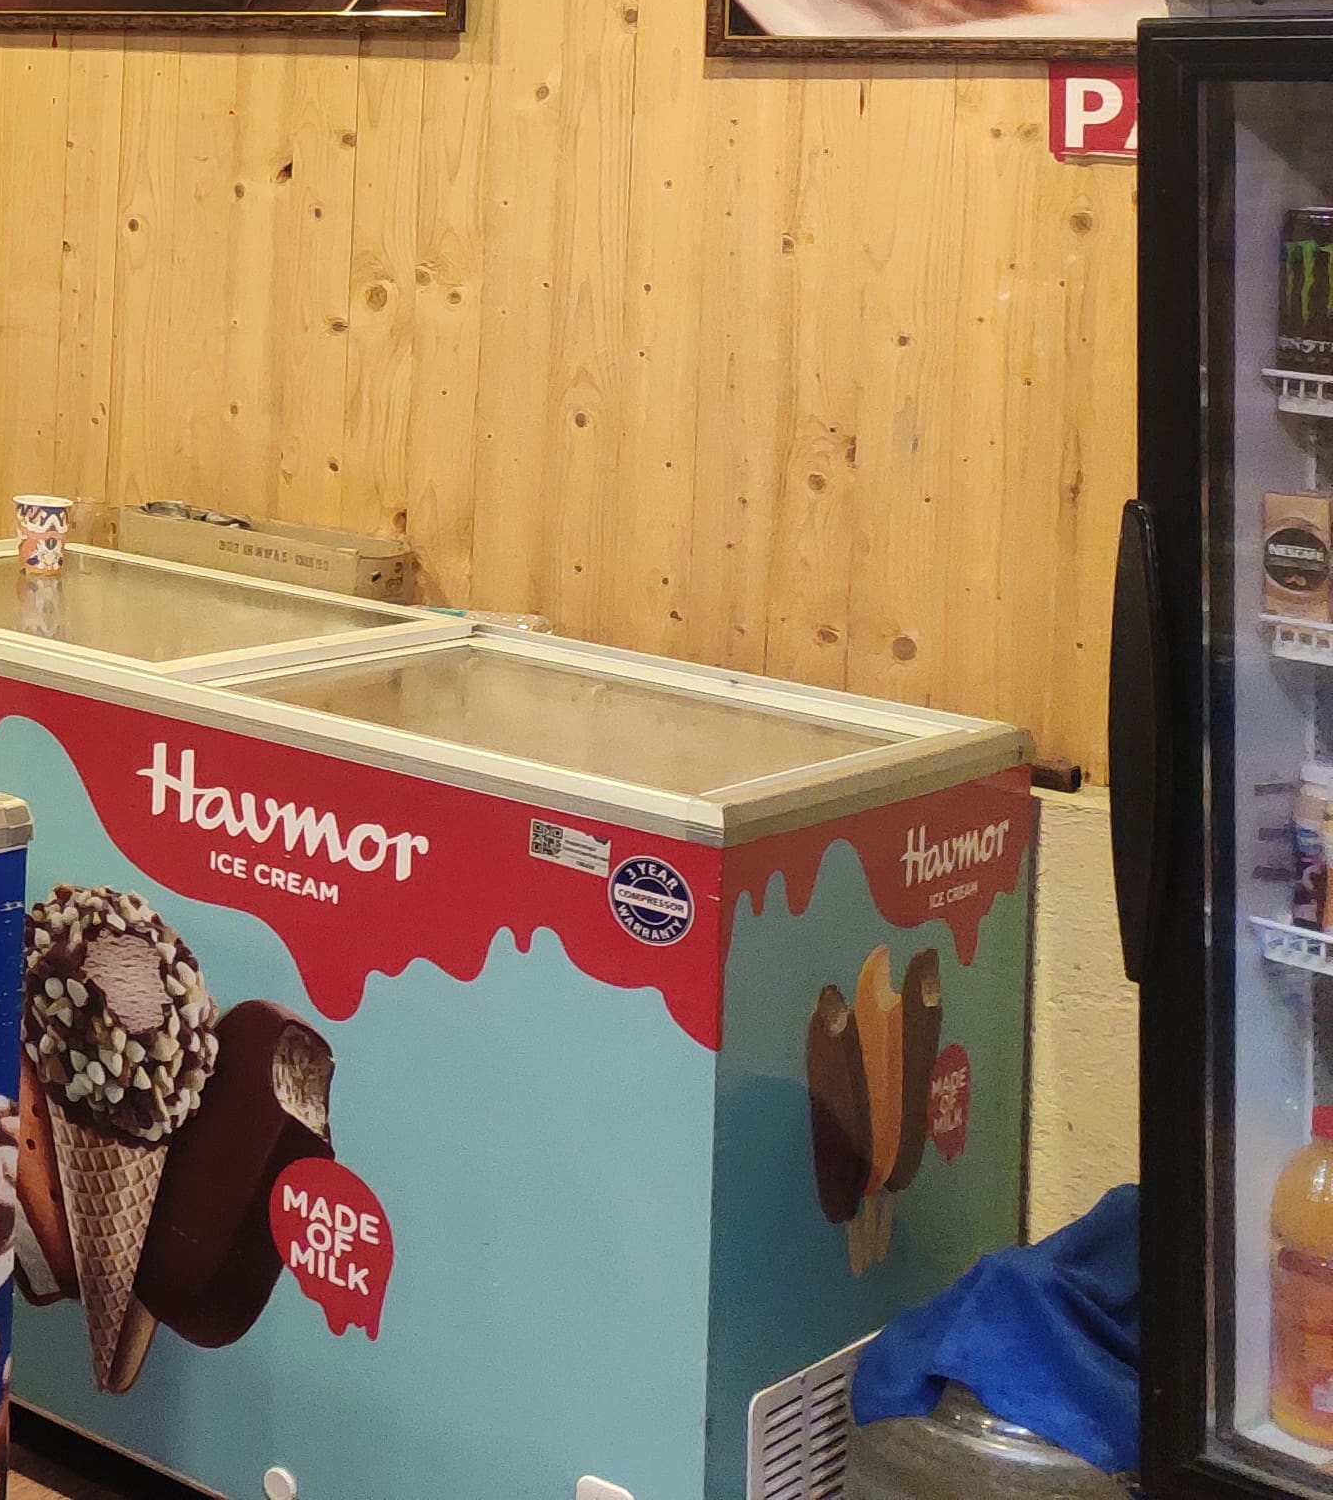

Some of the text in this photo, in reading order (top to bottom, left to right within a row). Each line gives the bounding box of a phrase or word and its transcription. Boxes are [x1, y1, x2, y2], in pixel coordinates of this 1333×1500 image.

[1065, 77, 1137, 150] P
[135, 742, 429, 881] Havmor
[899, 819, 1009, 888] Havmor
[210, 850, 339, 905] ICE CREAM
[625, 863, 679, 891] 3 YEAR
[617, 888, 685, 914] COMPRESSOR
[617, 904, 683, 940] WARRANTY
[932, 1066, 967, 1098] MADE
[933, 1107, 963, 1136] MILK
[939, 1093, 957, 1115] OF
[283, 1184, 380, 1245] MADE
[306, 1222, 354, 1258] OF
[290, 1241, 370, 1296] MILK
